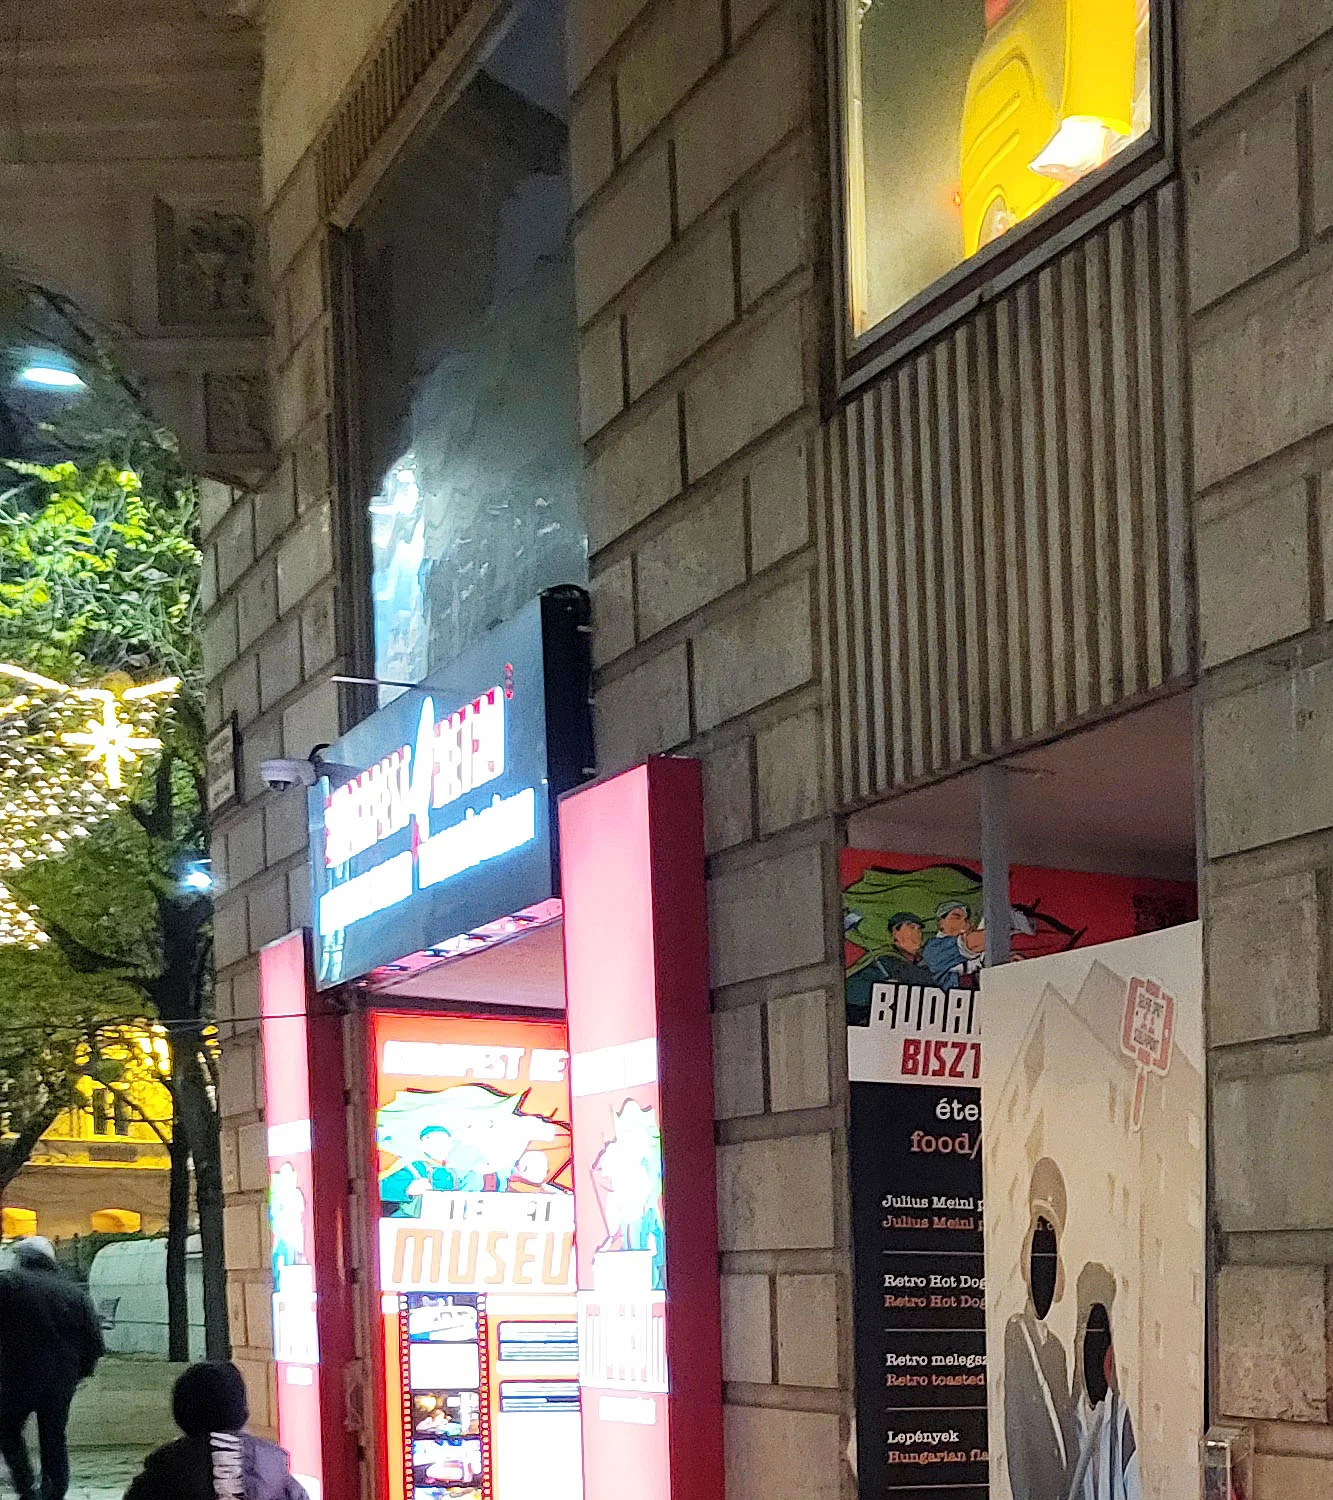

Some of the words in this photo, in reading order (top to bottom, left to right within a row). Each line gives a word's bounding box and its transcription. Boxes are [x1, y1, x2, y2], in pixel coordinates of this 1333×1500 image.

[936, 1097, 982, 1121] éte
[882, 1194, 928, 1209] Julius
[932, 1195, 974, 1210] Meinl
[883, 1215, 928, 1229] Julius
[933, 1216, 974, 1230] Meinl
[884, 1275, 926, 1288] Retro
[930, 1275, 957, 1288] Hot
[884, 1294, 927, 1308] Retro
[931, 1295, 957, 1308] Hot
[886, 1353, 928, 1366] Retro
[887, 1373, 928, 1387] Retro
[932, 1373, 985, 1386] toasted
[887, 1429, 960, 1445] Lepények
[888, 1450, 966, 1465] Hungarian
